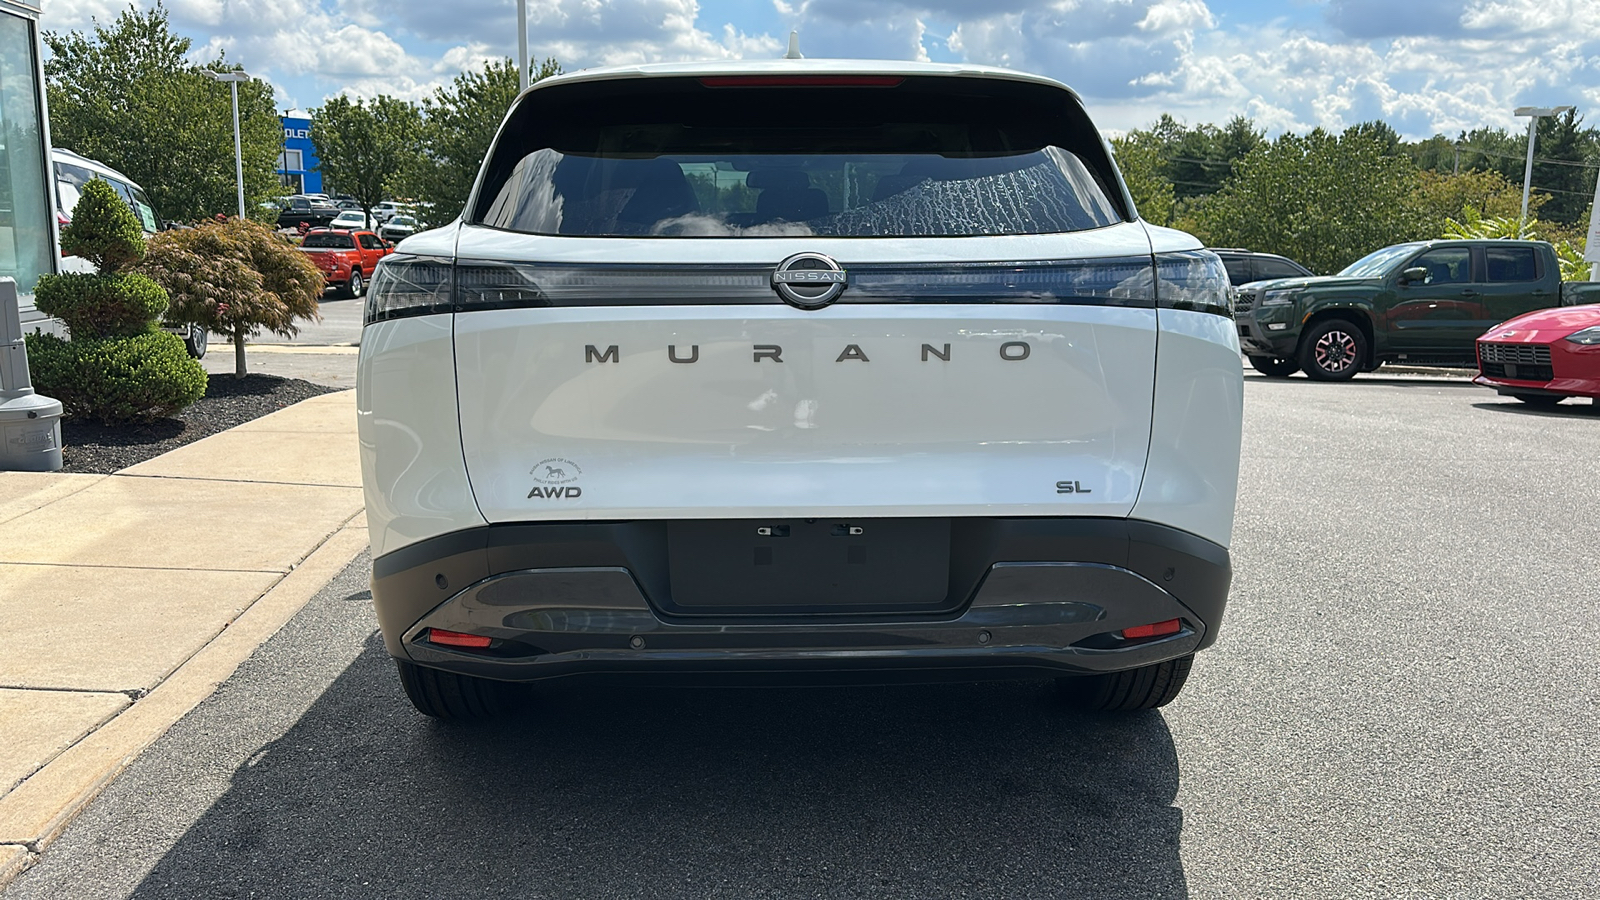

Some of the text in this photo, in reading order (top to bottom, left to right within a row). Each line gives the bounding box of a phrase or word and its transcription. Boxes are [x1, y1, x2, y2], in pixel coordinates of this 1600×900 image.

[776, 273, 844, 281] NISSAN
[585, 341, 1031, 363] MURANO
[527, 486, 582, 499] AWD
[1056, 481, 1091, 493] SL
